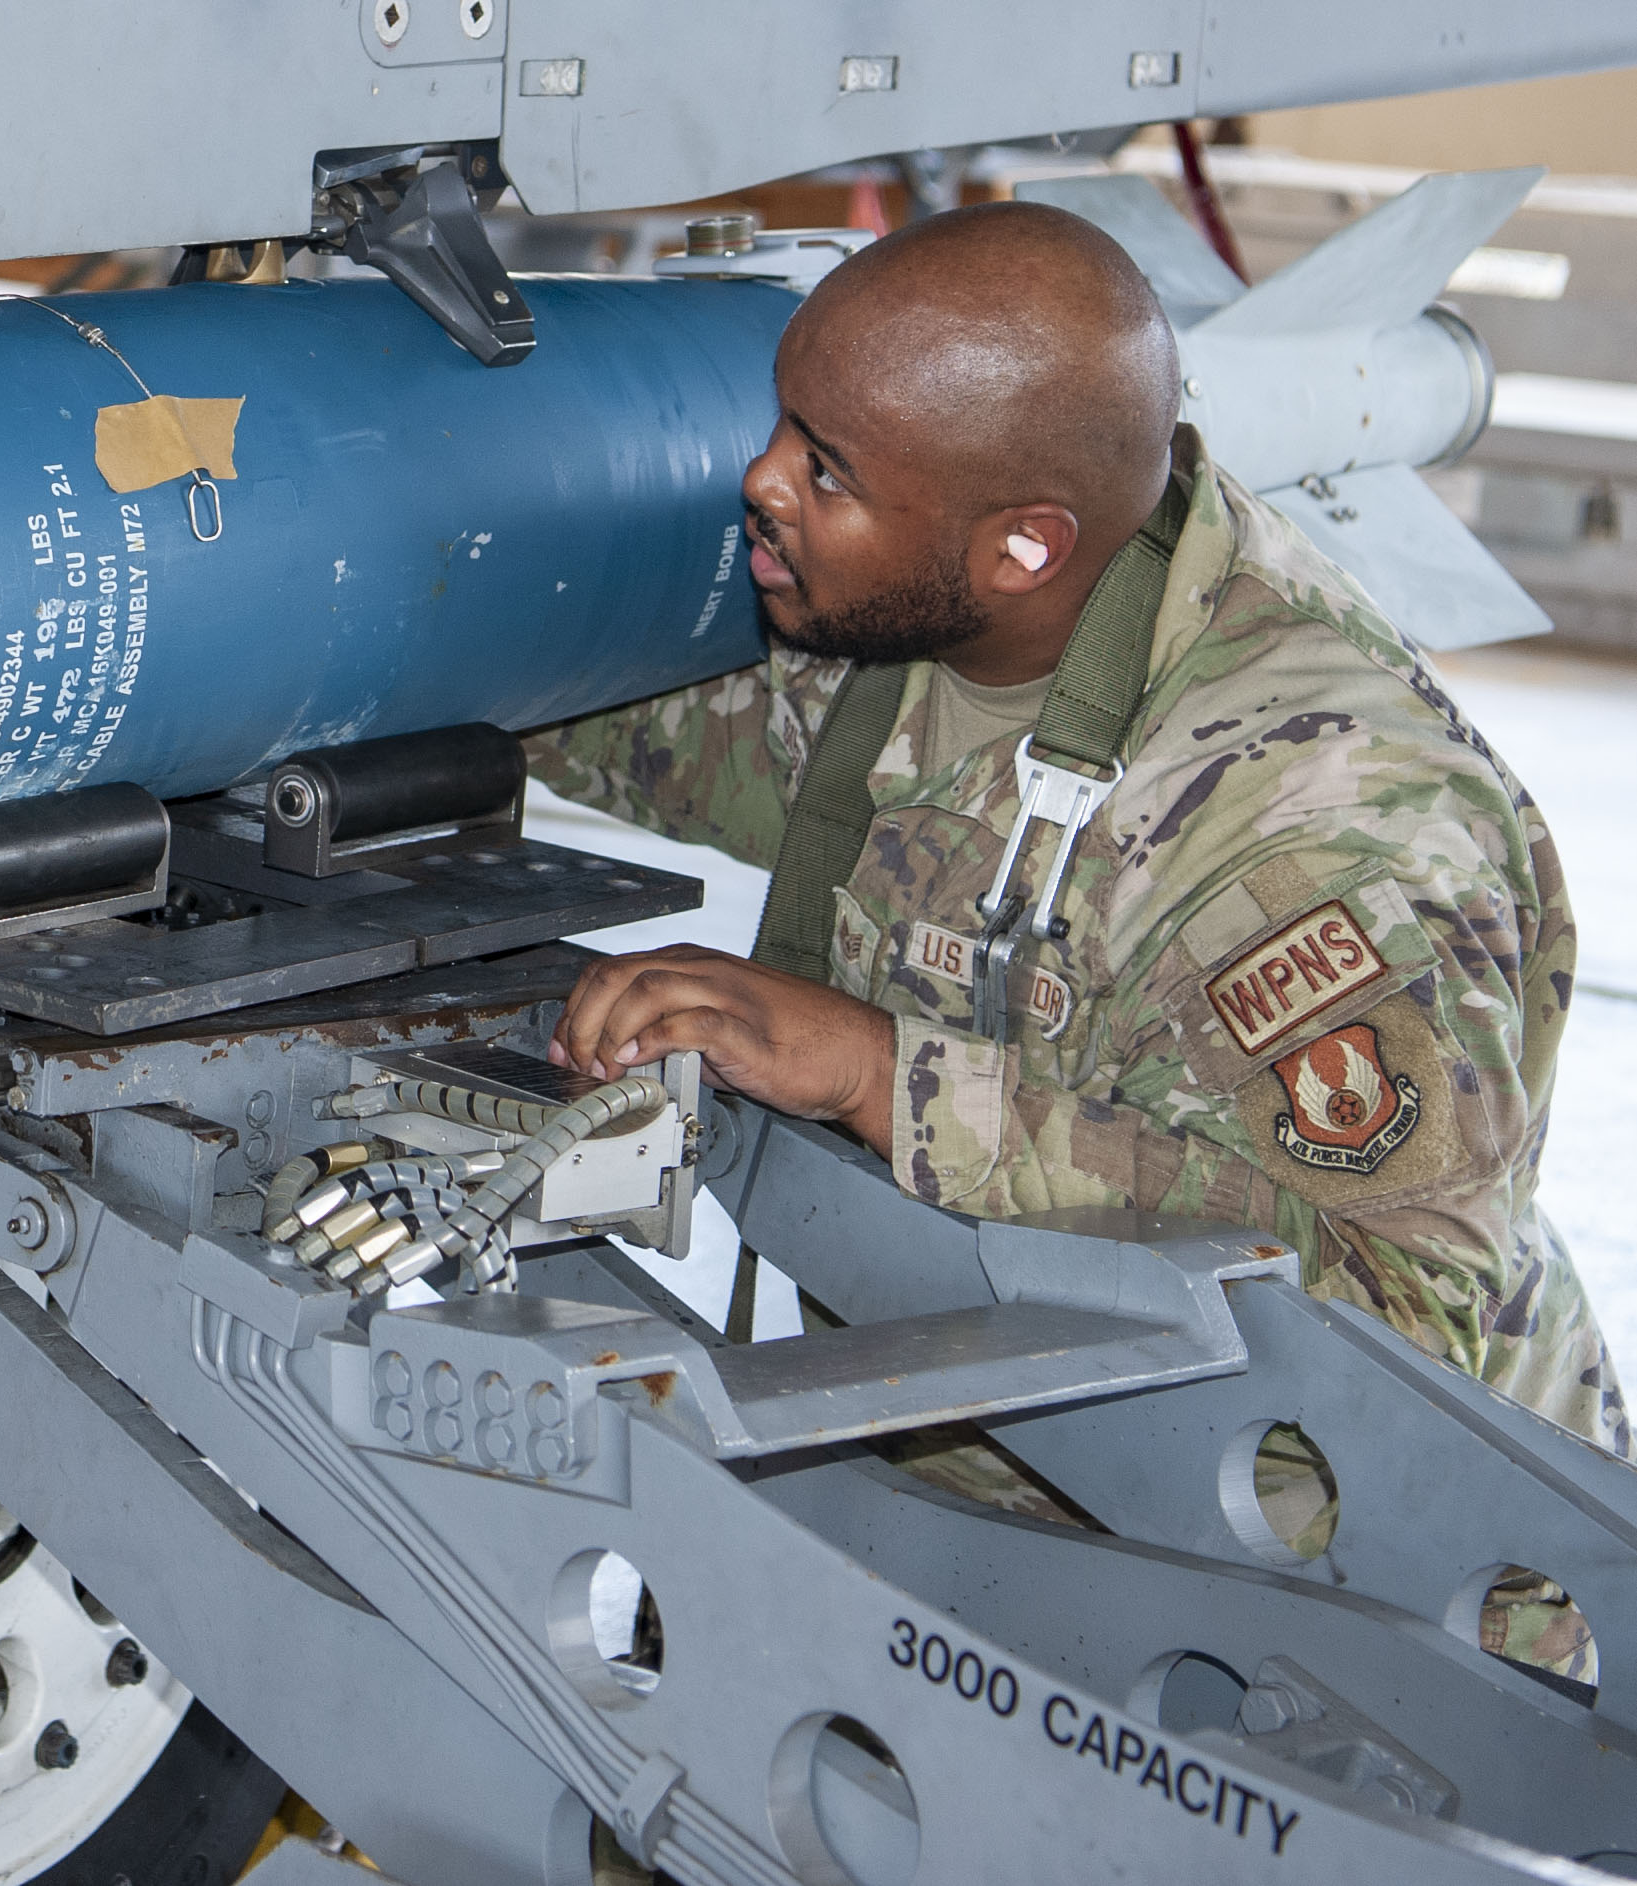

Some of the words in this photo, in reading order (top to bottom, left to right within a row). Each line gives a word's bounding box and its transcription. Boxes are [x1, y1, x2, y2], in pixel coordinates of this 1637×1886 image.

[43, 463, 73, 497] 2.1
[28, 514, 54, 565] LBS
[57, 508, 81, 538] FT
[121, 503, 146, 552] M72
[65, 552, 87, 587] CU
[690, 590, 724, 638] INERT
[715, 524, 739, 582] BOMB
[65, 601, 87, 649] LBS
[116, 566, 148, 695] ASSEMBLY
[20, 681, 46, 717] WT
[52, 667, 82, 724] 472
[11, 725, 32, 742] C
[77, 703, 127, 772] CABLE
[923, 932, 964, 977] U.S.
[1219, 921, 1363, 1035] WPNS
[1288, 1140, 1309, 1157] AIR
[1309, 1147, 1343, 1164] FORCE
[1383, 1103, 1417, 1143] COMMAND
[888, 1617, 1020, 1718] 3000
[1042, 1693, 1301, 1856] CAPACITY
